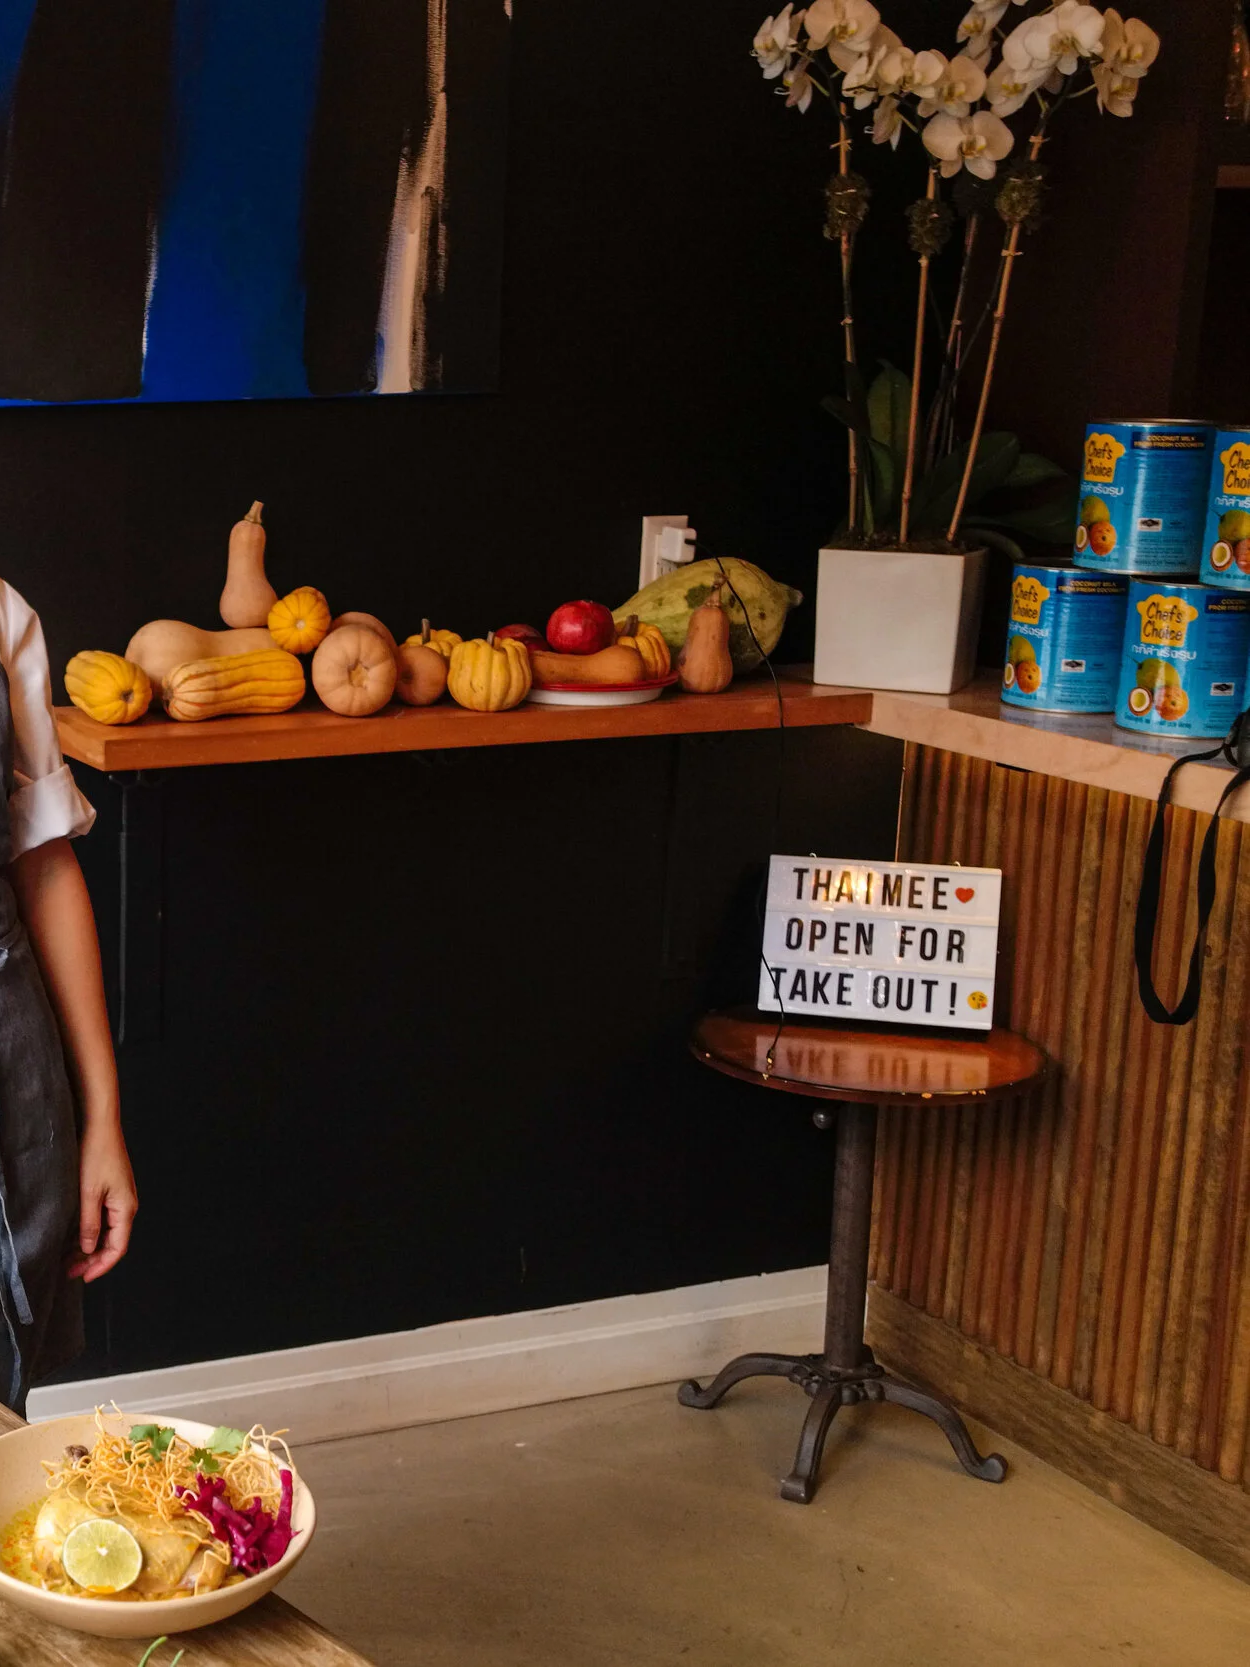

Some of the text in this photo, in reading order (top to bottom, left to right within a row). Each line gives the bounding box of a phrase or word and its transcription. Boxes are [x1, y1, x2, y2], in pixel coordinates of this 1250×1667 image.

[1088, 440, 1113, 460] Chef's
[1086, 458, 1113, 477] Choice
[1015, 582, 1039, 602] Chef's
[1014, 599, 1038, 619] Choice
[1146, 602, 1183, 623] Chef's
[1143, 620, 1183, 641] Choice
[785, 918, 966, 964] OPEN FOR
[770, 967, 958, 1016] TAKE OUT!
